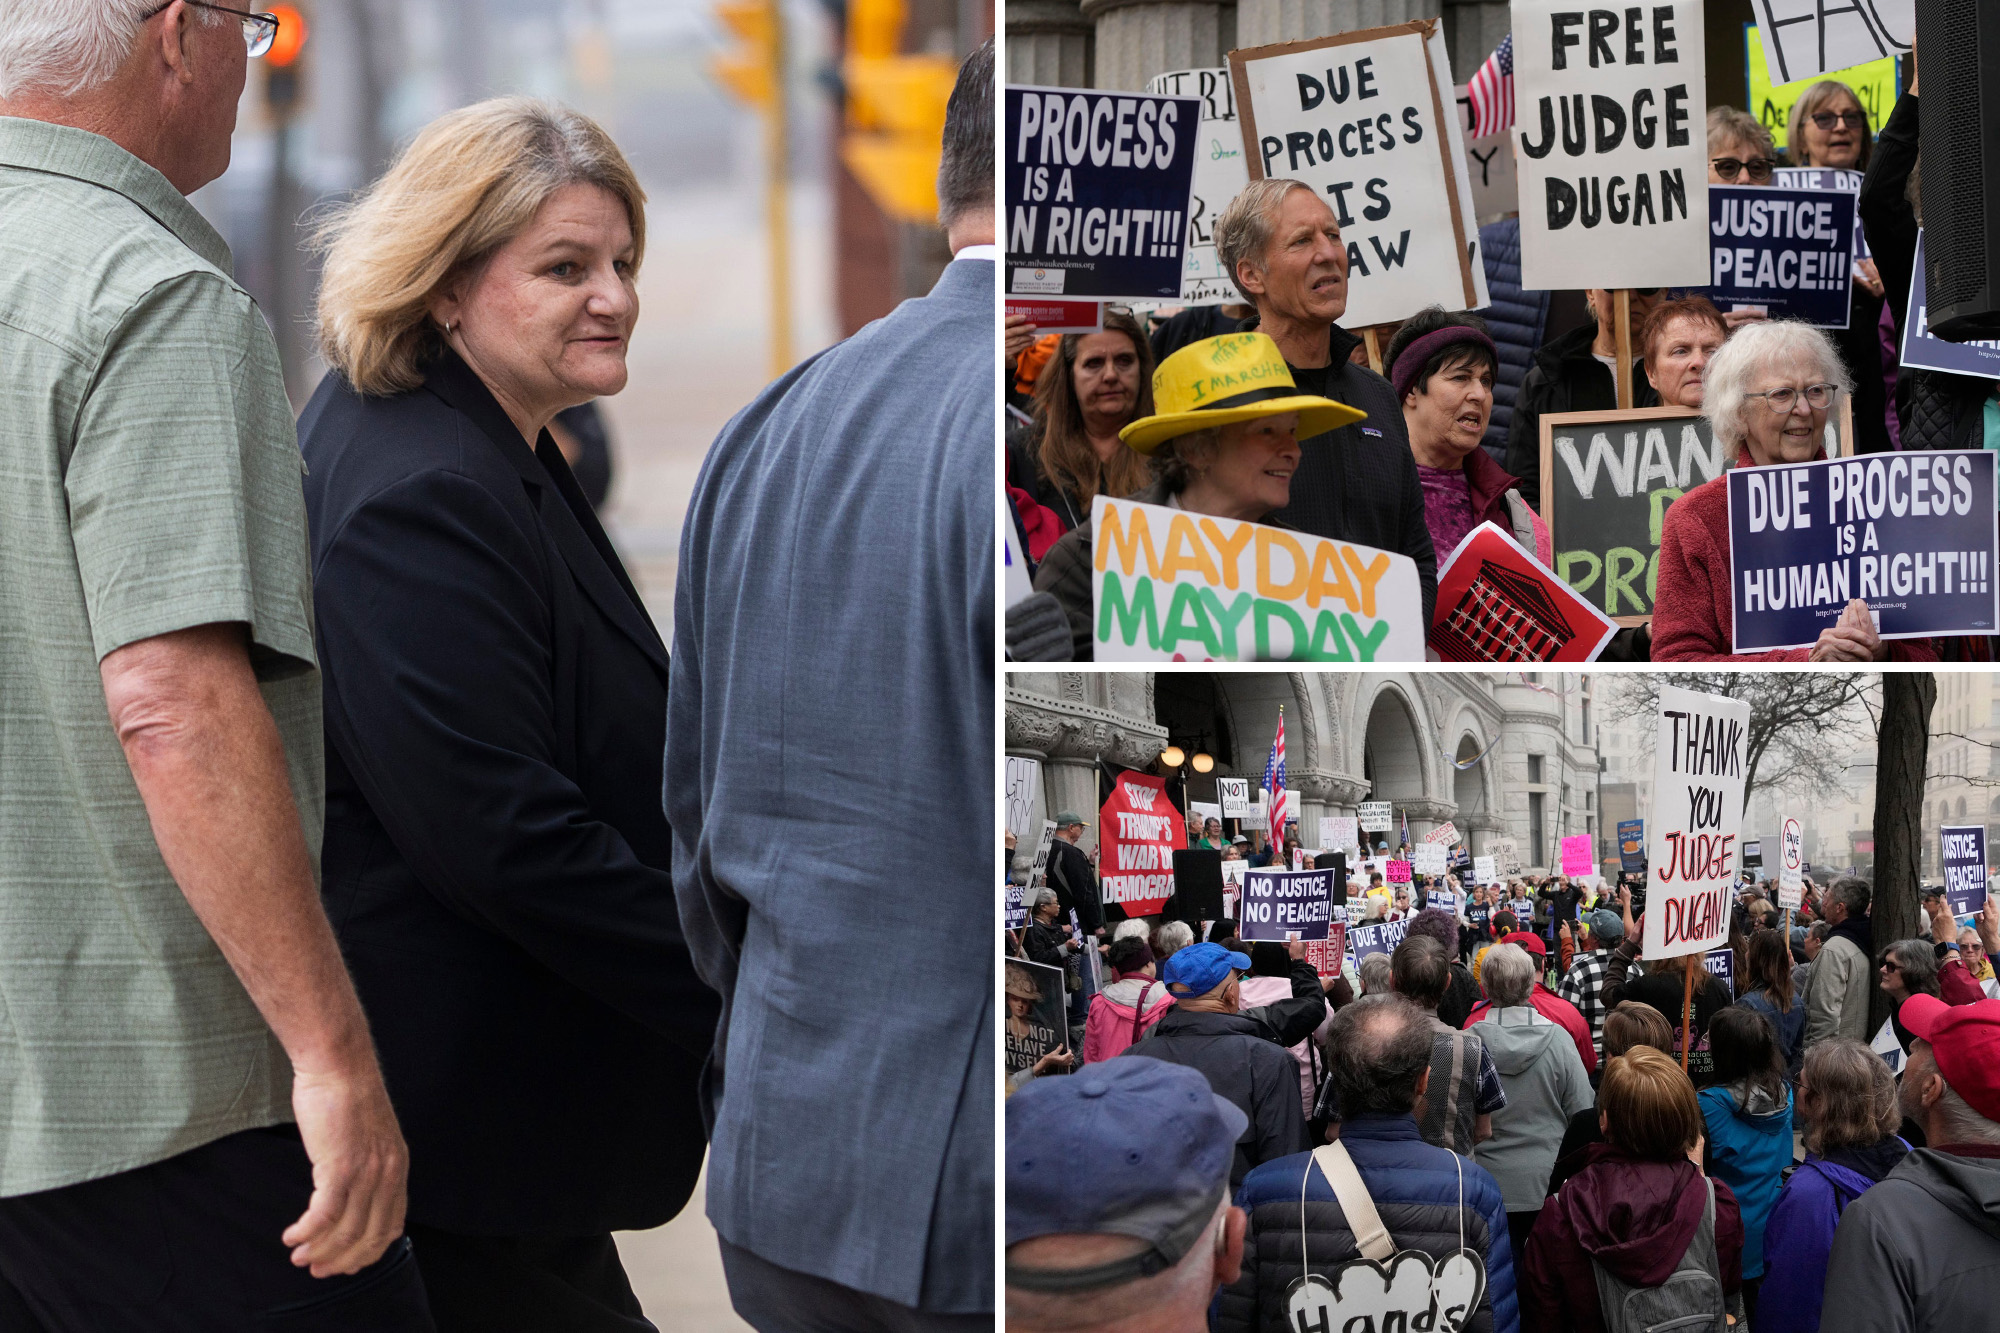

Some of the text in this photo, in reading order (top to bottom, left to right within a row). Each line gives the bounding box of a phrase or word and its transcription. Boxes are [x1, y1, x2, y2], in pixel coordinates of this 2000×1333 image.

[1551, 5, 1679, 71] FREE
[1297, 56, 1379, 112] DUE
[1018, 93, 1178, 170] PROCESS
[1520, 83, 1690, 159] JUDGE
[1261, 106, 1423, 177] PROCESS
[1024, 166, 1074, 203] IS A
[1327, 177, 1391, 228] IS
[1545, 168, 1688, 230] DUGAN
[1046, 206, 1181, 258] RIGHT!!!
[1711, 199, 1838, 249] JUSTICE,
[1347, 229, 1411, 278] AW
[1713, 247, 1846, 291] PEACE!!!
[1748, 468, 1811, 533] DUE
[1828, 455, 1973, 525] PROCESS
[1836, 521, 1879, 556] IS A
[1095, 503, 1391, 618] MAYDAY
[1744, 551, 1988, 613] HUMAN RIGHT!!!
[1097, 571, 1390, 662] MAYDAY
[1663, 710, 1743, 779] THANK
[1123, 781, 1159, 811] STOP
[1222, 782, 1247, 798] NOT
[1224, 800, 1249, 811] GUILTY
[1688, 785, 1723, 833] YOU
[1117, 811, 1173, 842] TRUMP'S
[1327, 818, 1353, 830] HANDS
[1334, 829, 1347, 838] OFF
[1786, 832, 1800, 845] SAVE
[1117, 844, 1159, 870] WAR
[1657, 830, 1736, 884] JUDGE
[1787, 848, 1798, 860] ACT
[1102, 873, 1176, 905] DEMOCRA
[1250, 875, 1327, 900] NO JUSTICE,
[1386, 874, 1410, 882] PEOPLE
[1948, 864, 1984, 892] PEACE!!!
[1246, 902, 1271, 923] NO
[1276, 900, 1330, 923] PEACE!!!
[1664, 886, 1729, 947] DUGAN!
[1326, 928, 1337, 972] DROP
[1355, 927, 1378, 948] DUE
[1380, 920, 1409, 943] PROC
[1386, 942, 1395, 952] IS
[1705, 956, 1728, 976] TICE,
[1005, 1035, 1046, 1057] EHAVE
[1029, 1024, 1055, 1043] NOT
[1296, 1275, 1466, 1333] Hands
